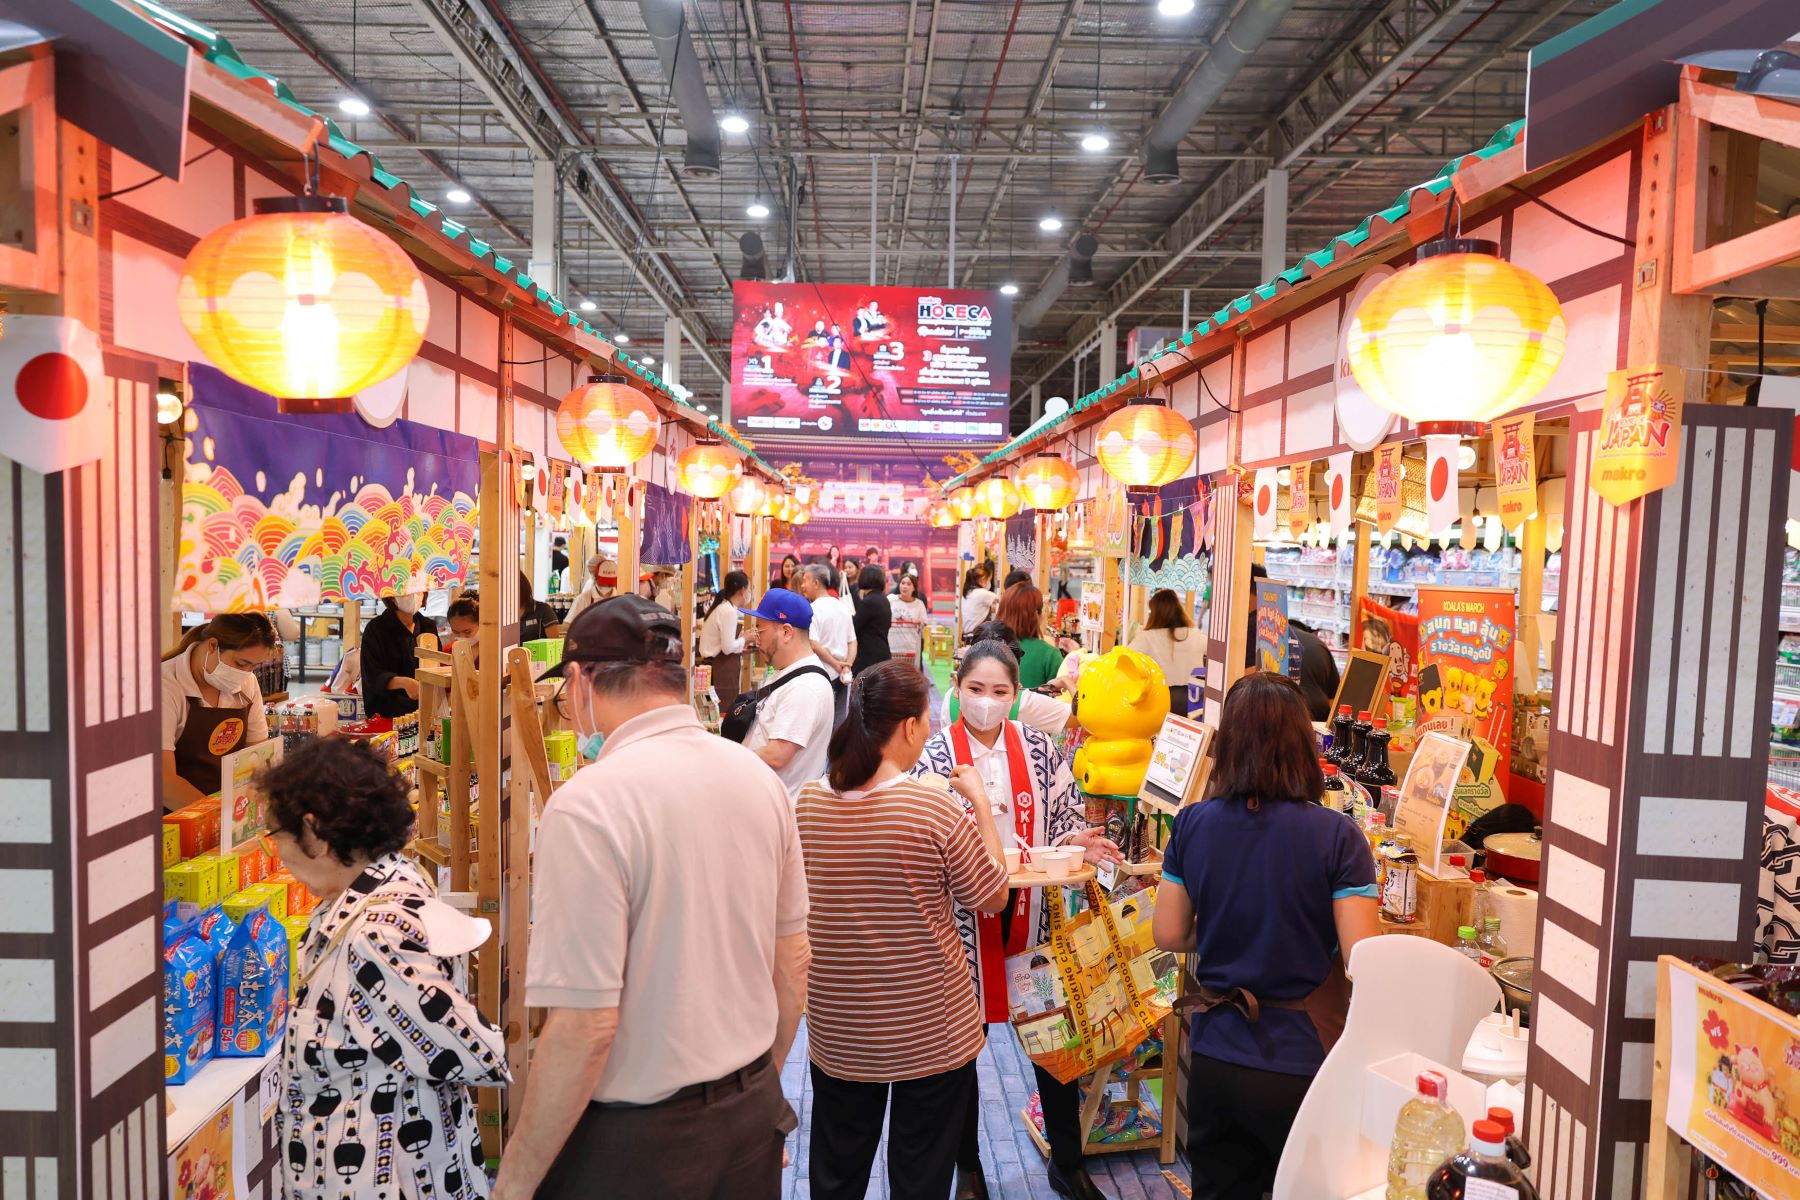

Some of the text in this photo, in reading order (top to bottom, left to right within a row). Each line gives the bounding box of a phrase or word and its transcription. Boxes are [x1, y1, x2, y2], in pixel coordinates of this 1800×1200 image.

[919, 304, 991, 320] HORECA
[889, 342, 905, 360] 3
[761, 355, 774, 373] 1
[826, 375, 841, 393] 2
[1601, 417, 1670, 450] JAPAN
[1498, 461, 1529, 487] JAPAN
[1602, 466, 1647, 481] makro
[1443, 600, 1485, 613] KOALA'S MARCH
[1016, 810, 1031, 917] KIKKAN
[1052, 903, 1062, 930] SINO
[1055, 934, 1068, 963] CLUB
[1102, 905, 1114, 932] CLUB
[1111, 933, 1123, 959] SINO
[1120, 962, 1141, 1009] COOKING
[1064, 966, 1086, 1017] COOKING
[221, 1028, 234, 1043] 54
[1080, 1019, 1091, 1045] SINO
[1771, 1151, 1789, 1168] 999
